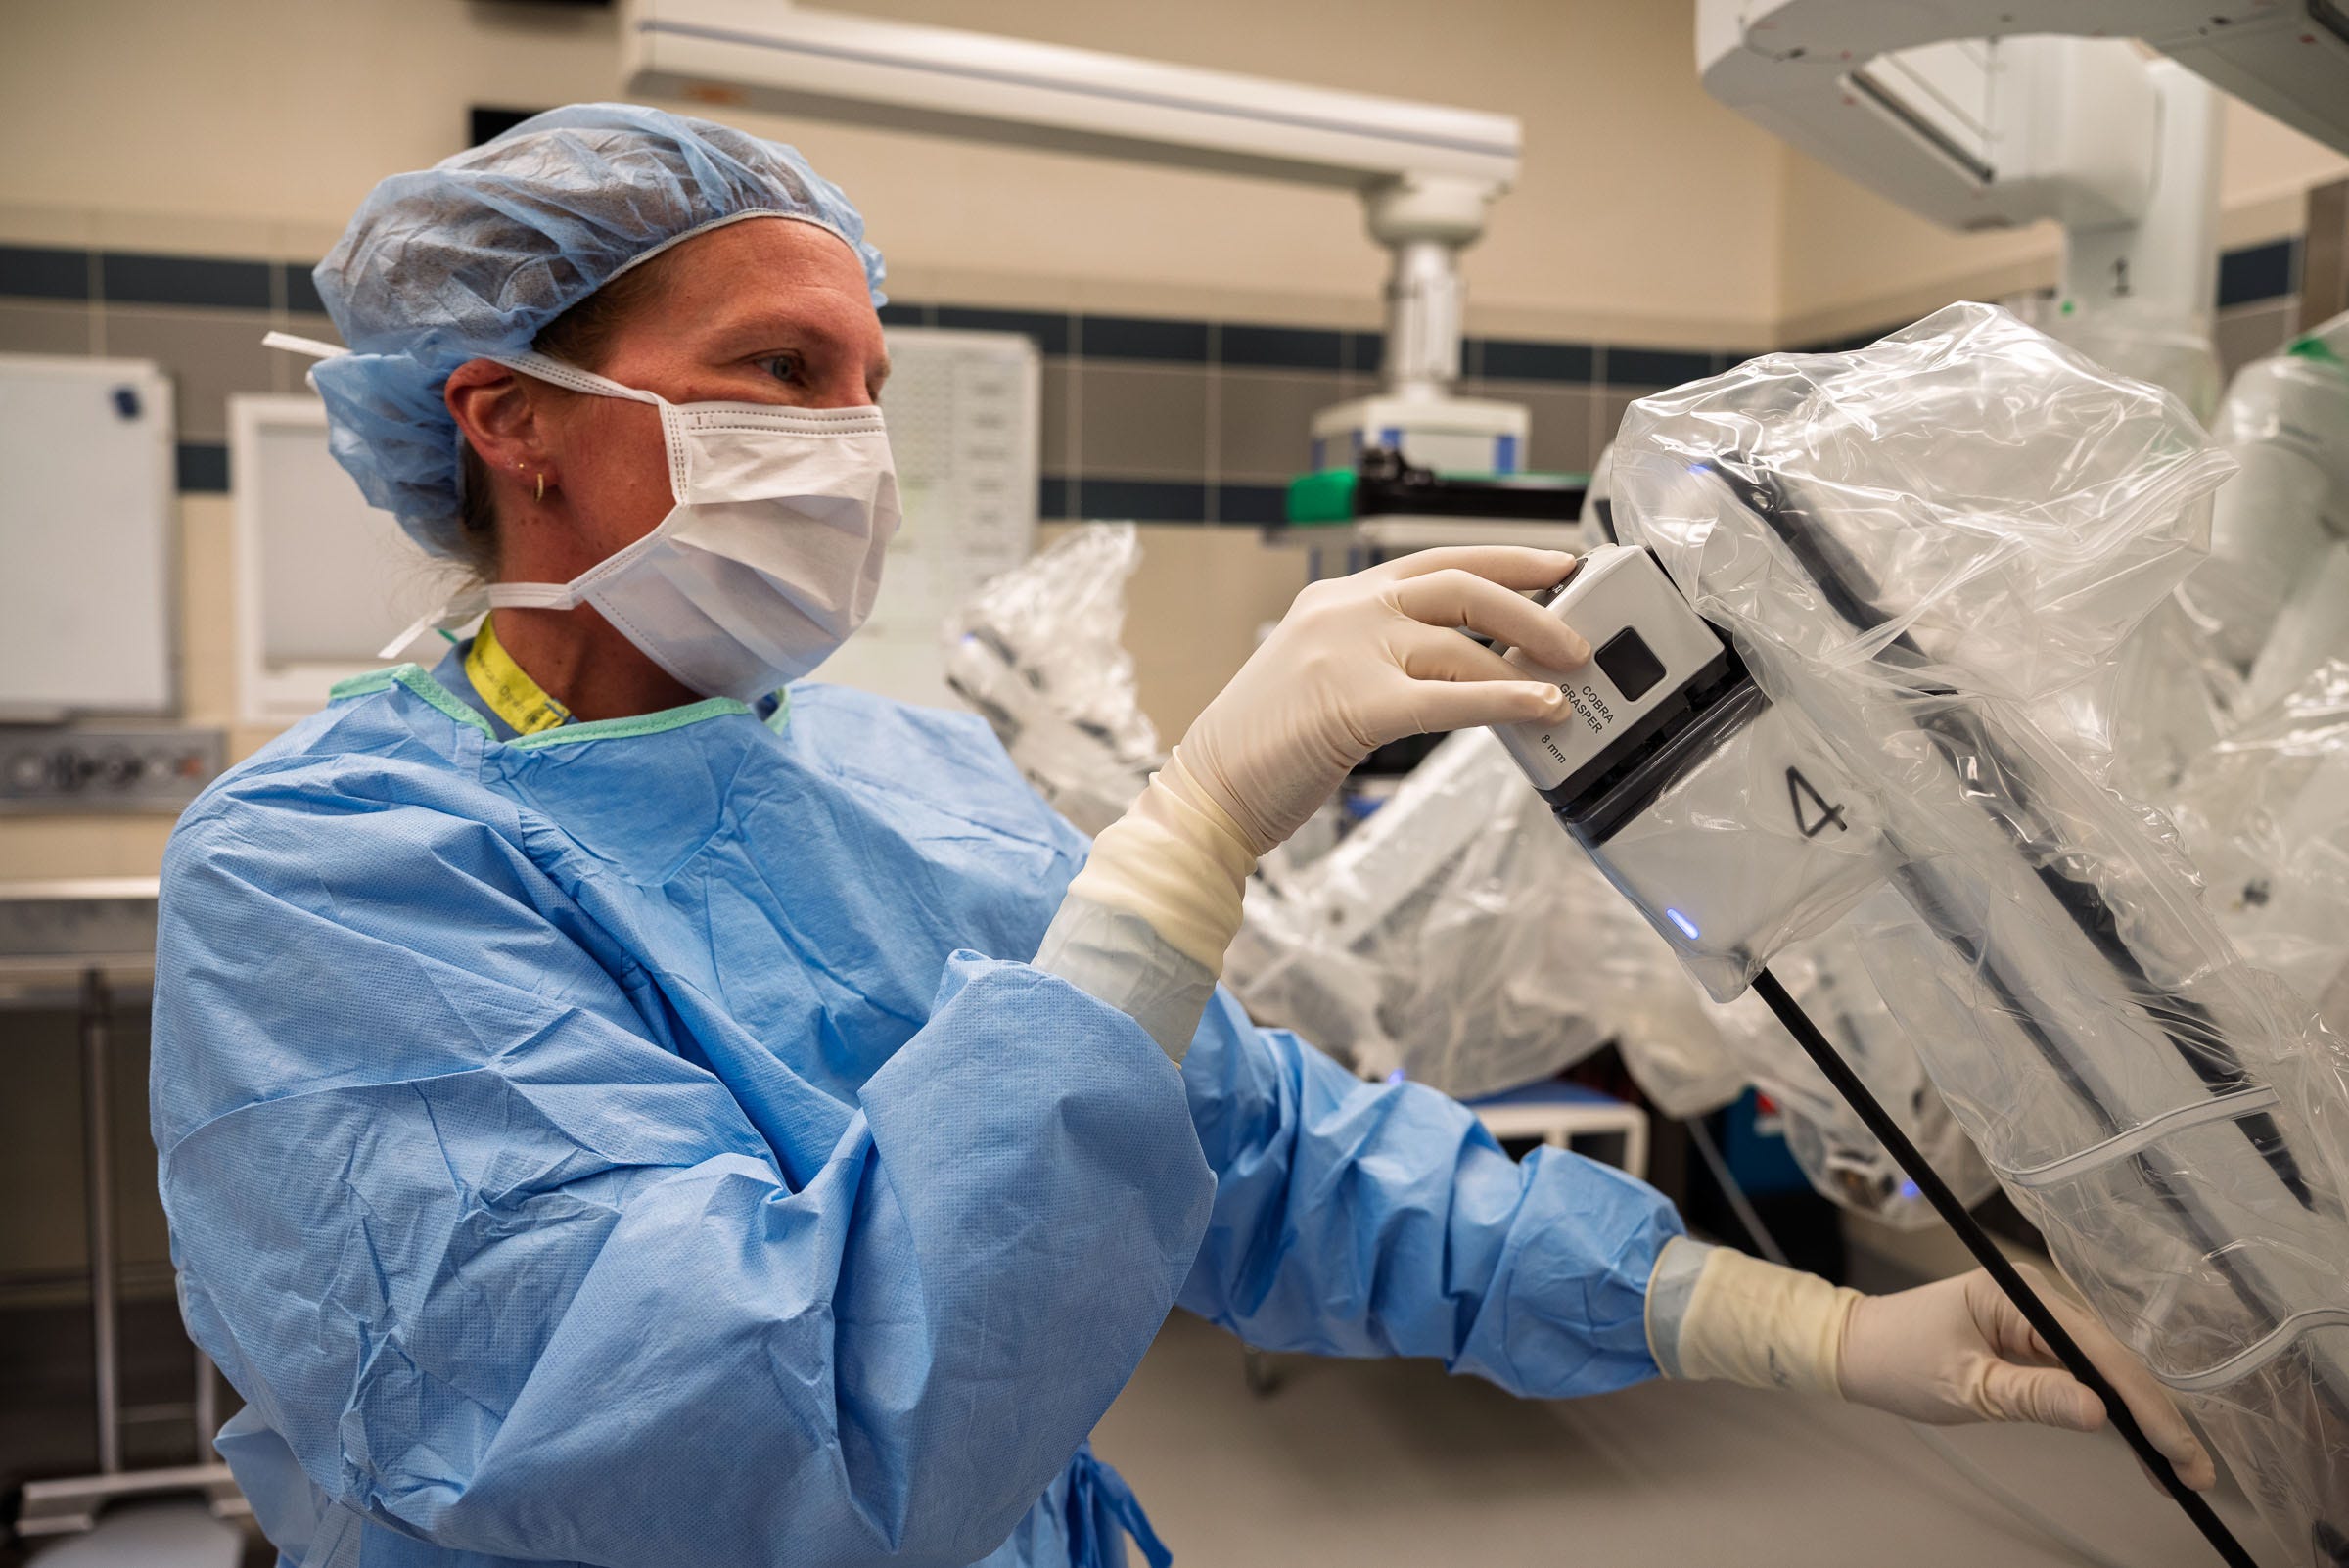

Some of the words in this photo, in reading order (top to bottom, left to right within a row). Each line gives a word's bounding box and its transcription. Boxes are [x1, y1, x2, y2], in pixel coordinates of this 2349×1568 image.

[1559, 683, 1603, 734] GRASPER
[1582, 686, 1614, 724] COBRA
[1541, 734, 1551, 744] 8
[1547, 744, 1567, 763] mm
[1785, 765, 1848, 838] 4
